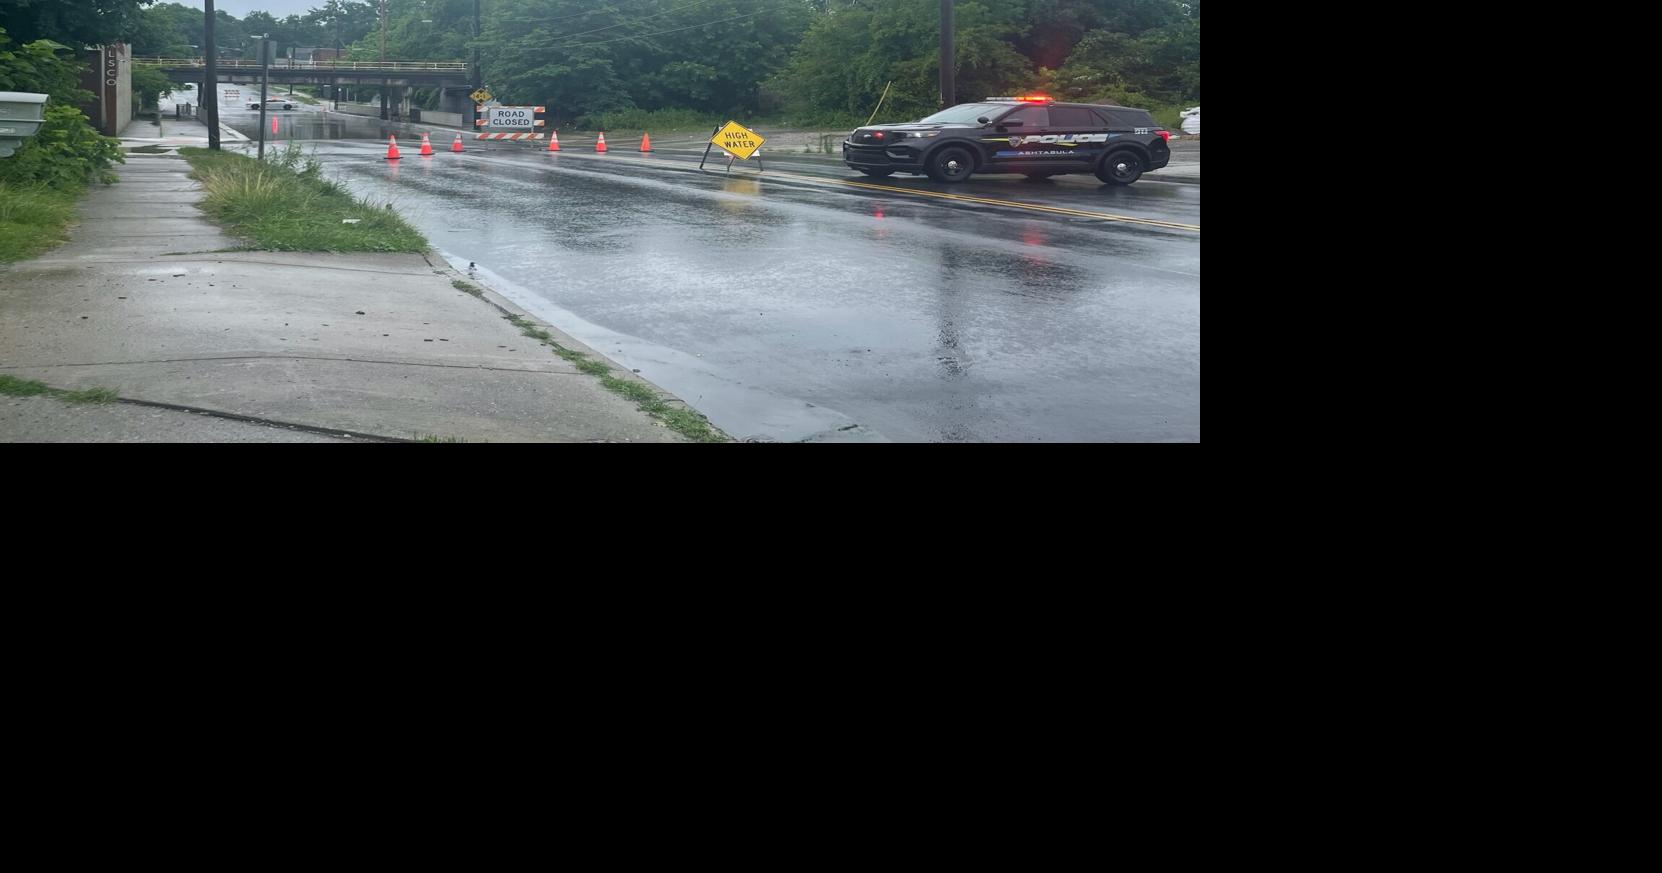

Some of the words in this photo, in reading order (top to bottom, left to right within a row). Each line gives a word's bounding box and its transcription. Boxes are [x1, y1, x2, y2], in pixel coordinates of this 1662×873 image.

[497, 110, 525, 118] ROAD
[724, 131, 748, 140] HIGH
[724, 140, 756, 148] WATER
